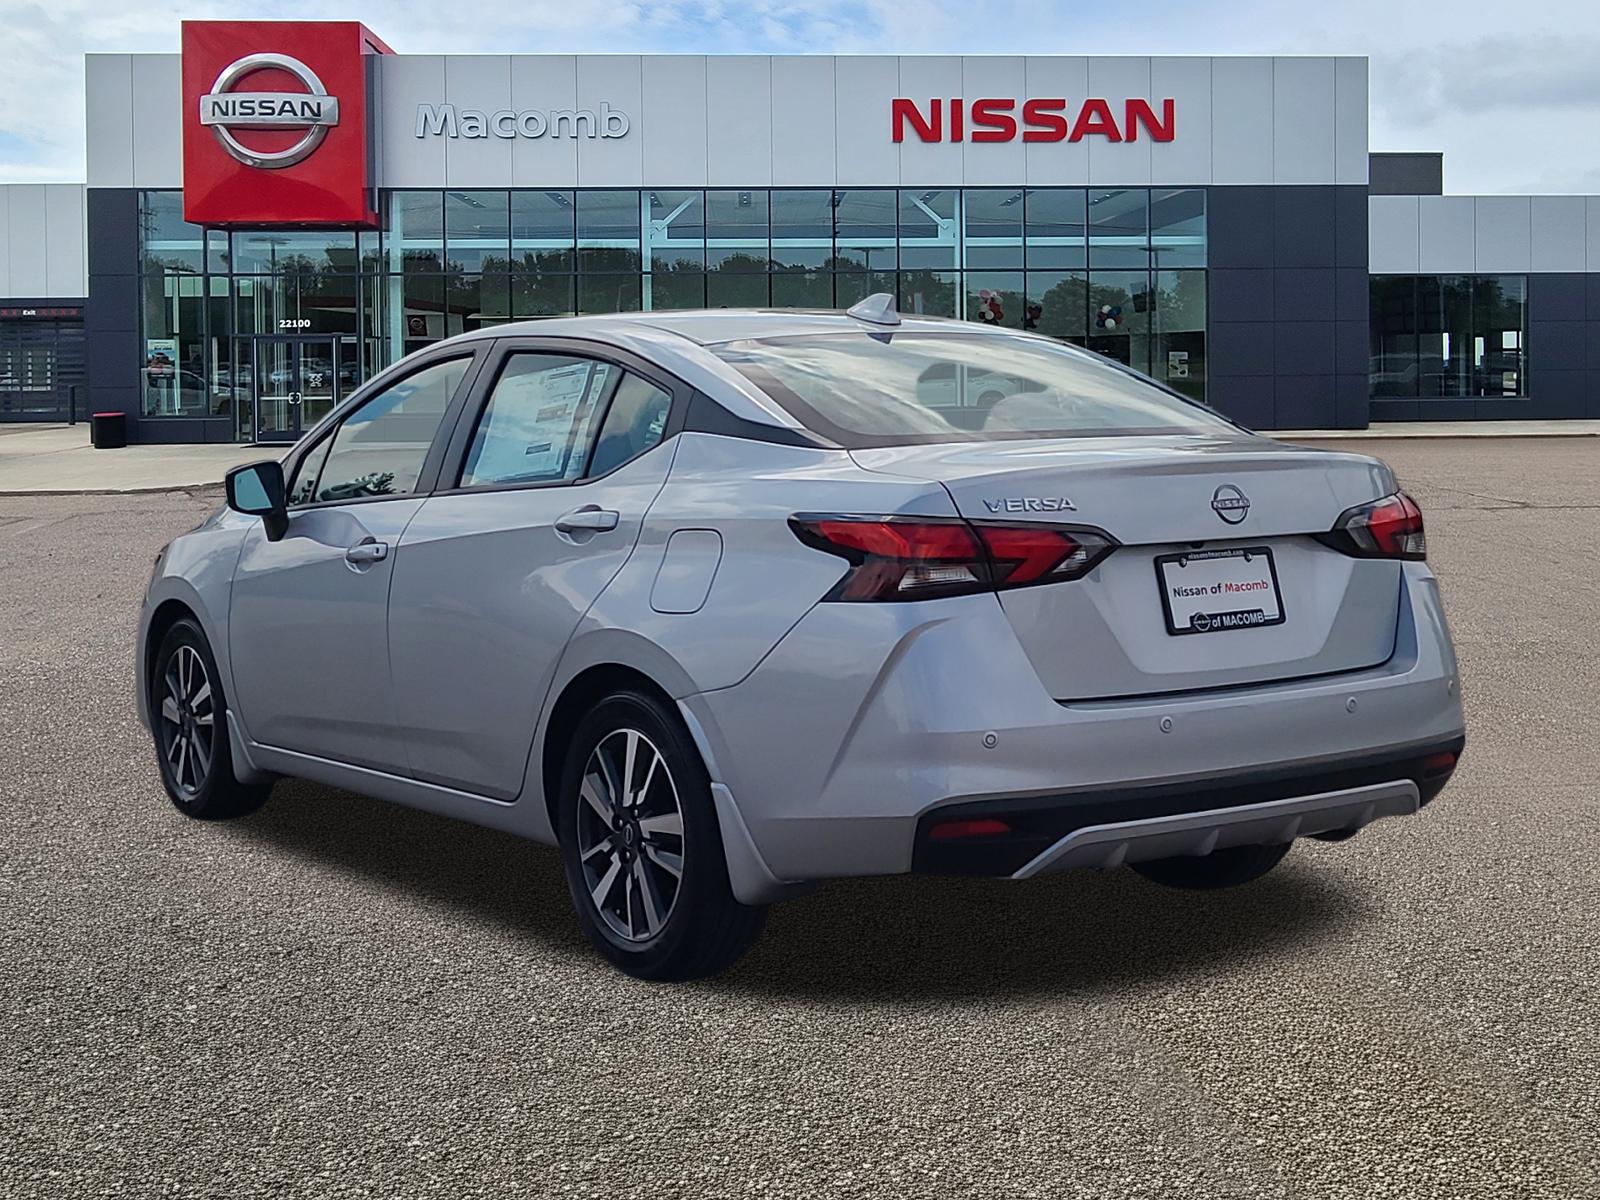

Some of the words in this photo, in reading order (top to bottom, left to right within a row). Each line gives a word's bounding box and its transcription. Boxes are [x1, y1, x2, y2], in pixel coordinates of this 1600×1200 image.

[211, 100, 322, 118] NISSAN
[415, 102, 630, 139] Macomb
[892, 98, 1175, 143] NISSAN
[279, 319, 311, 328] 22100
[982, 497, 1077, 513] VERSA
[1173, 587, 1207, 597] Nissan
[1210, 583, 1222, 594] of
[1225, 580, 1269, 592] Macomb
[1212, 618, 1221, 628] of
[1223, 612, 1265, 627] MACOMB
